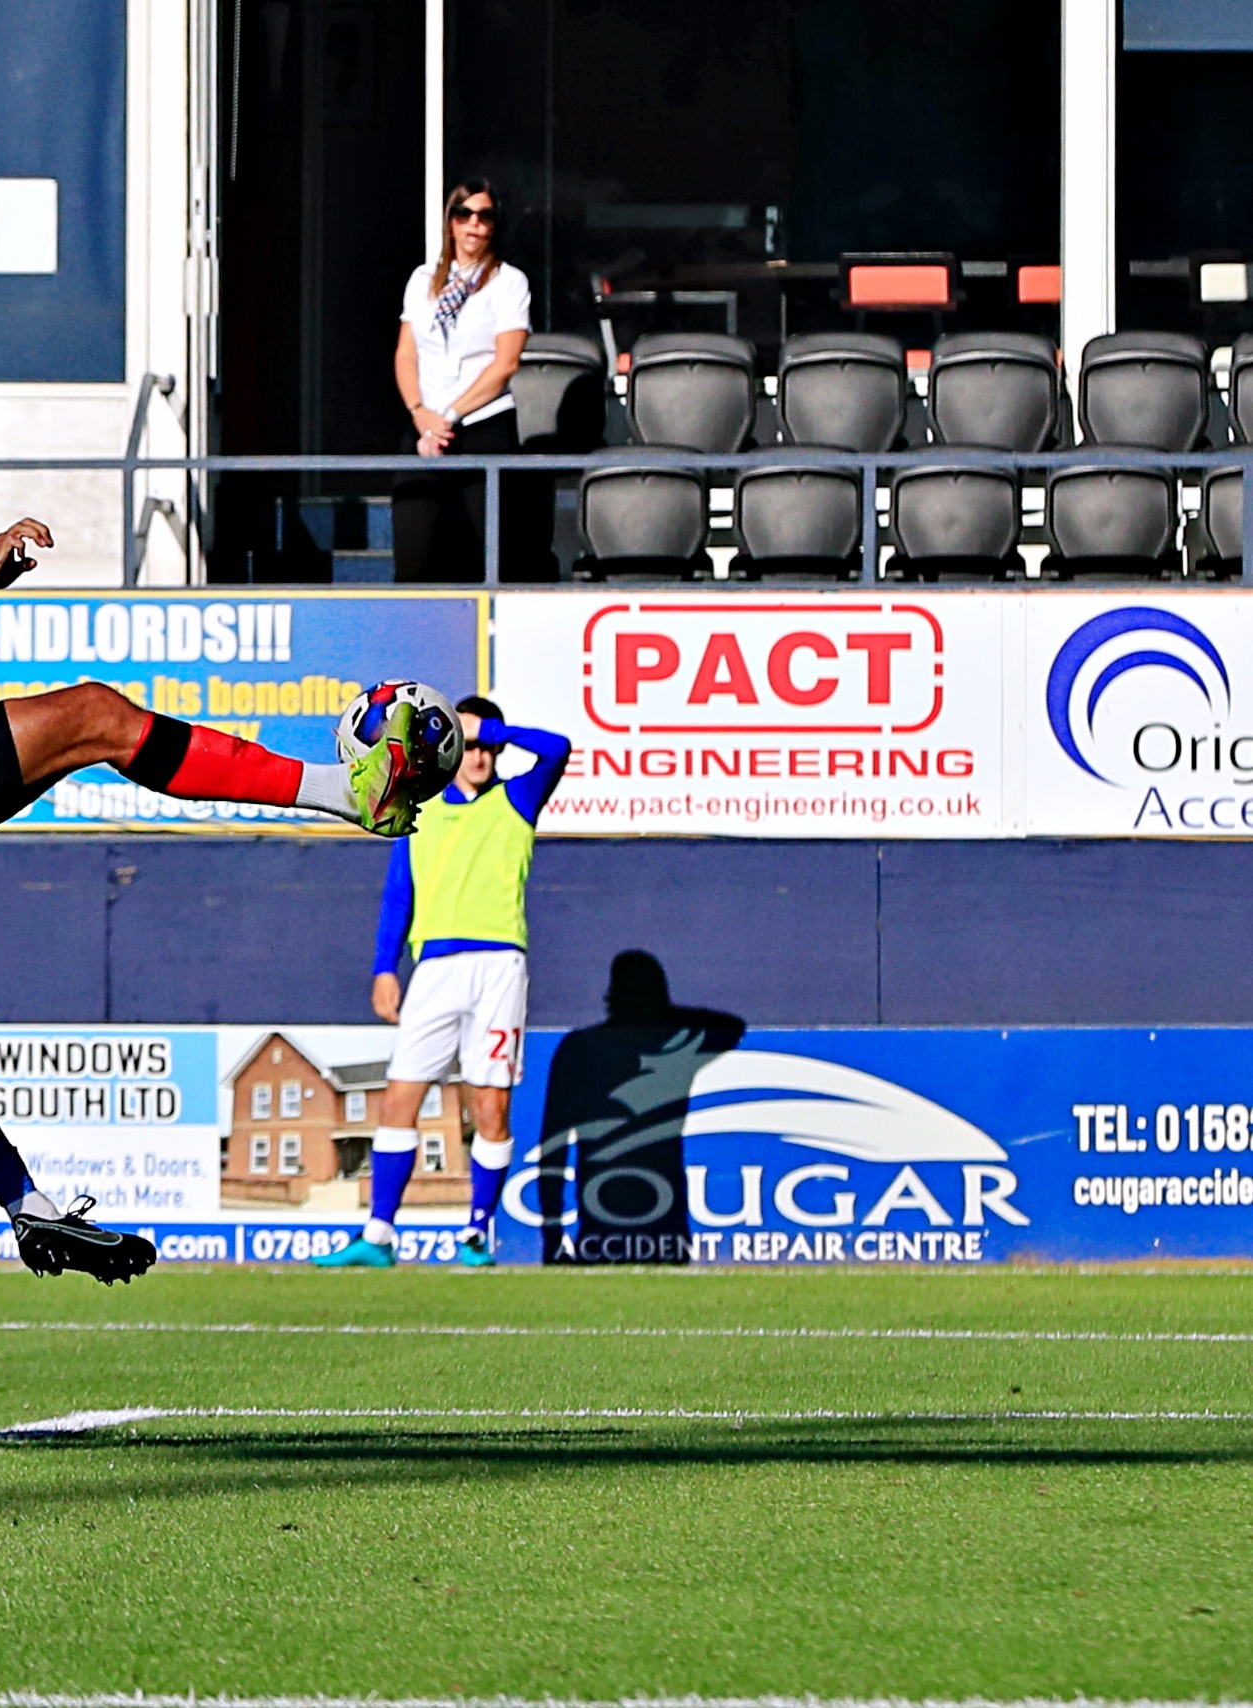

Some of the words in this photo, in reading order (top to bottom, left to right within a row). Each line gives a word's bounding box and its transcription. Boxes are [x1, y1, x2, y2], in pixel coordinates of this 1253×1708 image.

[614, 632, 912, 706] PACT
[152, 676, 202, 715] its
[207, 675, 363, 716] benefits
[565, 748, 974, 778] ENGINEERING
[546, 792, 982, 821] www.pact-engineering.co.uk
[486, 1029, 521, 1060] 21
[119, 1086, 177, 1119] LTD
[1072, 1104, 1148, 1152] TEL:
[1156, 1103, 1253, 1152] 0158
[123, 1154, 138, 1176] &
[500, 1164, 1031, 1228] COUGAR
[553, 1232, 723, 1261] ACCIDENT
[732, 1231, 846, 1262] REPAIR
[853, 1231, 983, 1262] CENTRE
